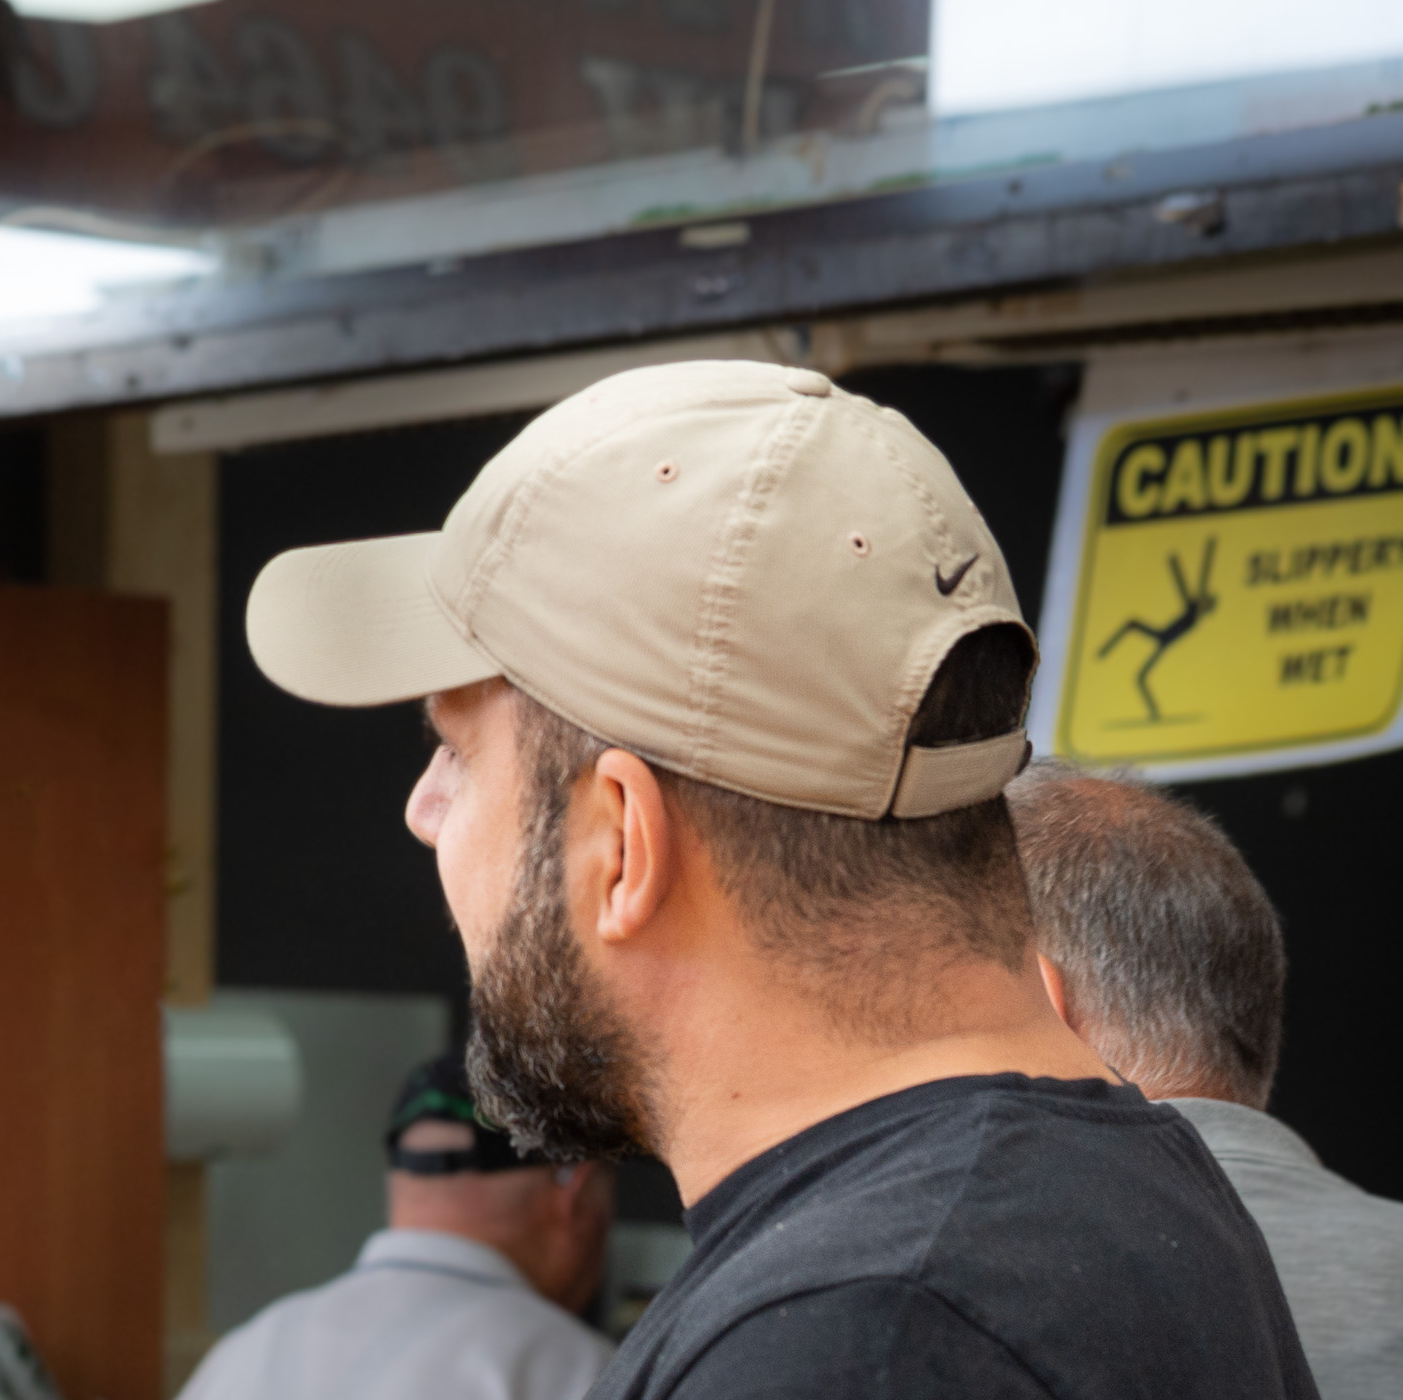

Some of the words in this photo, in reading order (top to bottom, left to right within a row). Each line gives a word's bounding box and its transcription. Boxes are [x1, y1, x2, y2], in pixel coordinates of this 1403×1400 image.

[1116, 414, 1403, 518] CAUTION
[1266, 594, 1372, 636] WHEN
[1279, 645, 1354, 686] WET
